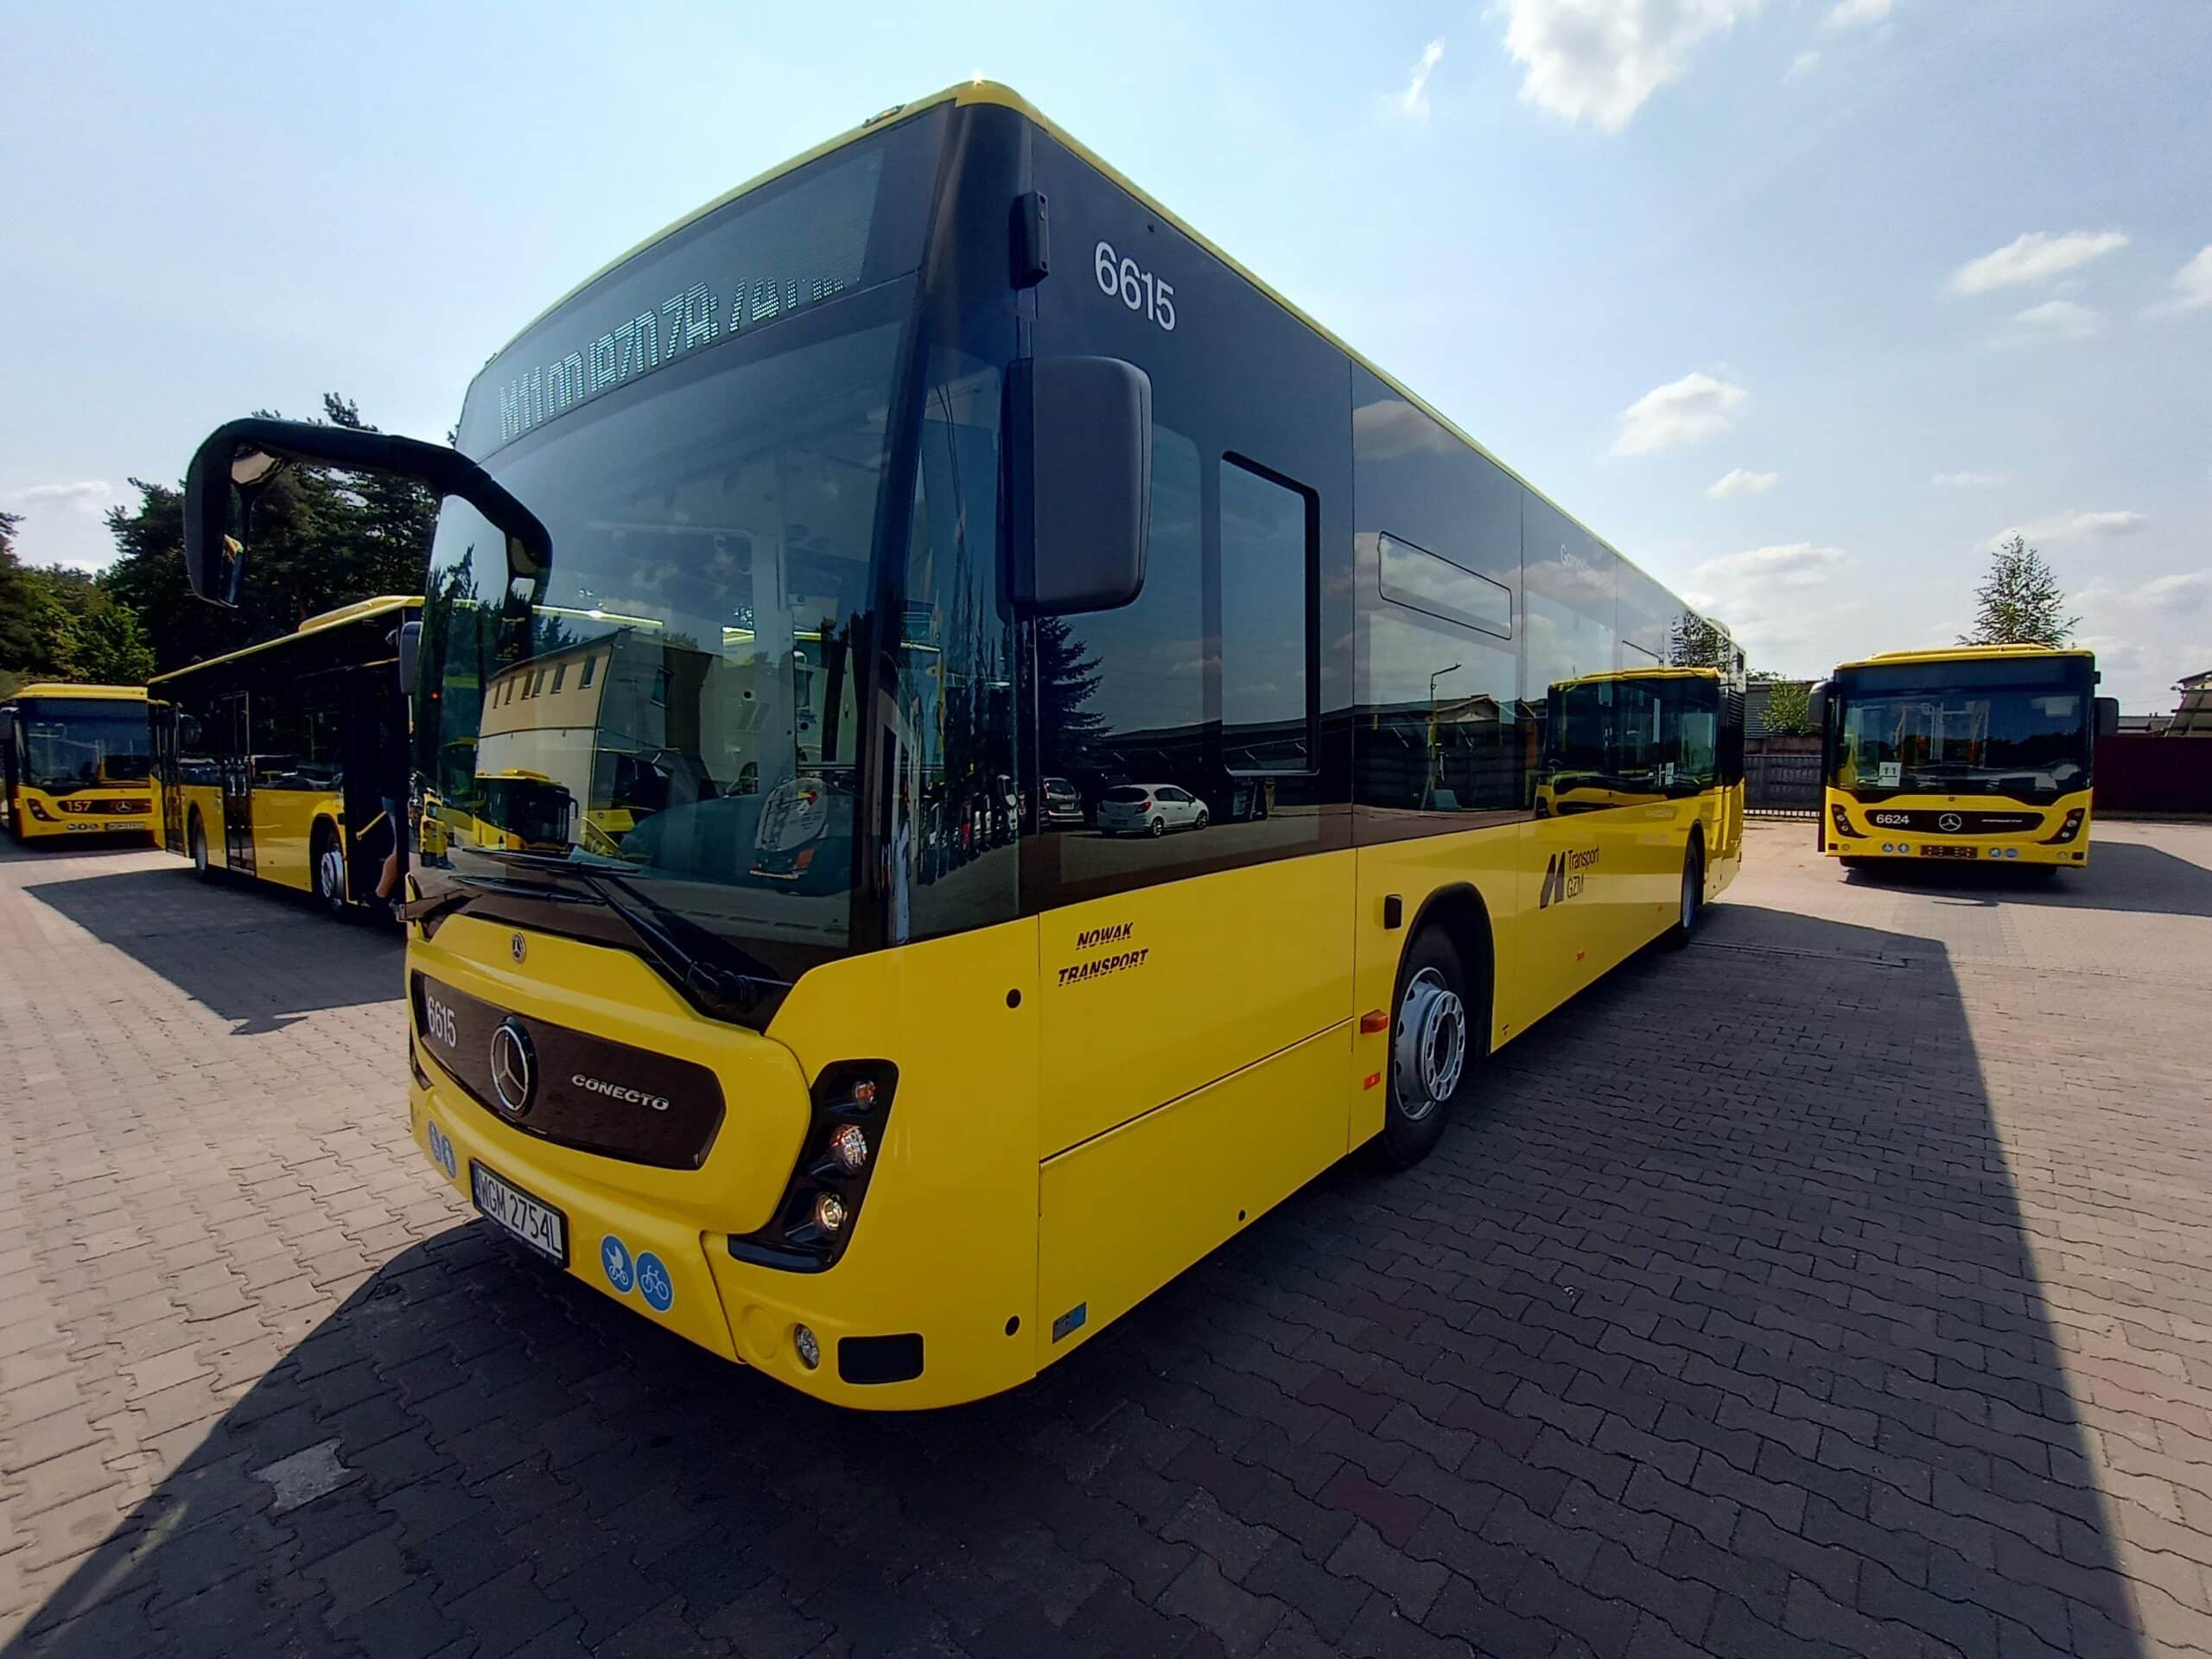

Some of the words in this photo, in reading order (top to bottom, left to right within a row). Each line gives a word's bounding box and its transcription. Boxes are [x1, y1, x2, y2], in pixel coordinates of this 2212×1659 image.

[1094, 241, 1176, 331] 6615
[1876, 813, 1910, 825] 6624
[1567, 845, 1599, 871] Transport
[1076, 922, 1134, 950] NOWAK
[1058, 949, 1149, 988] TRANSPORT
[427, 995, 457, 1048] 6615
[571, 1072, 671, 1112] CONECTO
[478, 1171, 506, 1222] WGM
[510, 1193, 563, 1254] 2754L
